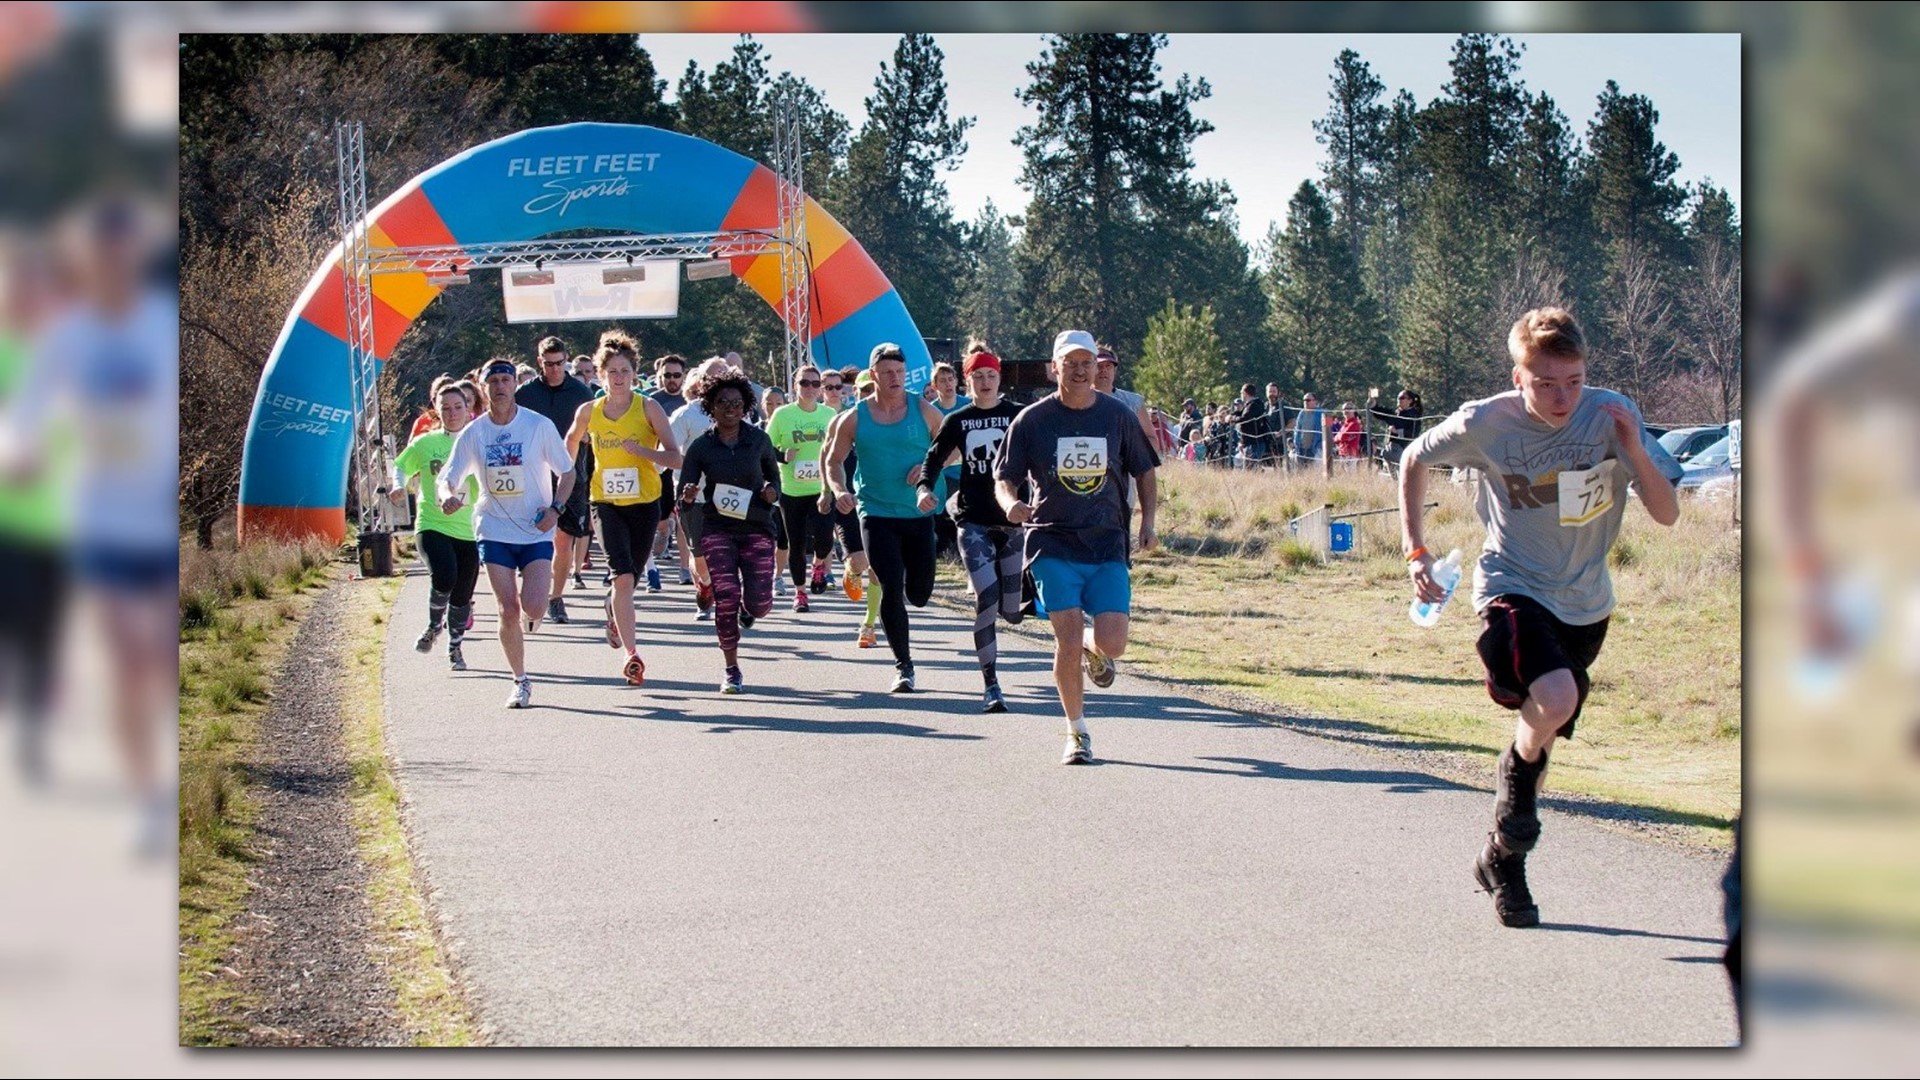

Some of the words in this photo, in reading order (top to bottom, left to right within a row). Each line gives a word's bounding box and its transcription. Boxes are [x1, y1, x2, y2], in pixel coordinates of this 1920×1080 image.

[508, 155, 589, 177] FLEET
[594, 153, 661, 173] FEET
[523, 175, 643, 217] Sports
[903, 366, 928, 388] EET
[307, 403, 353, 424] FEET
[258, 410, 337, 437] Sports
[961, 416, 1010, 431] PROTEIN
[1062, 452, 1102, 470] 654
[797, 469, 821, 480] 244
[495, 478, 516, 492] 20
[606, 480, 635, 494] 357
[721, 496, 741, 512] 99
[1578, 484, 1604, 516] 72
